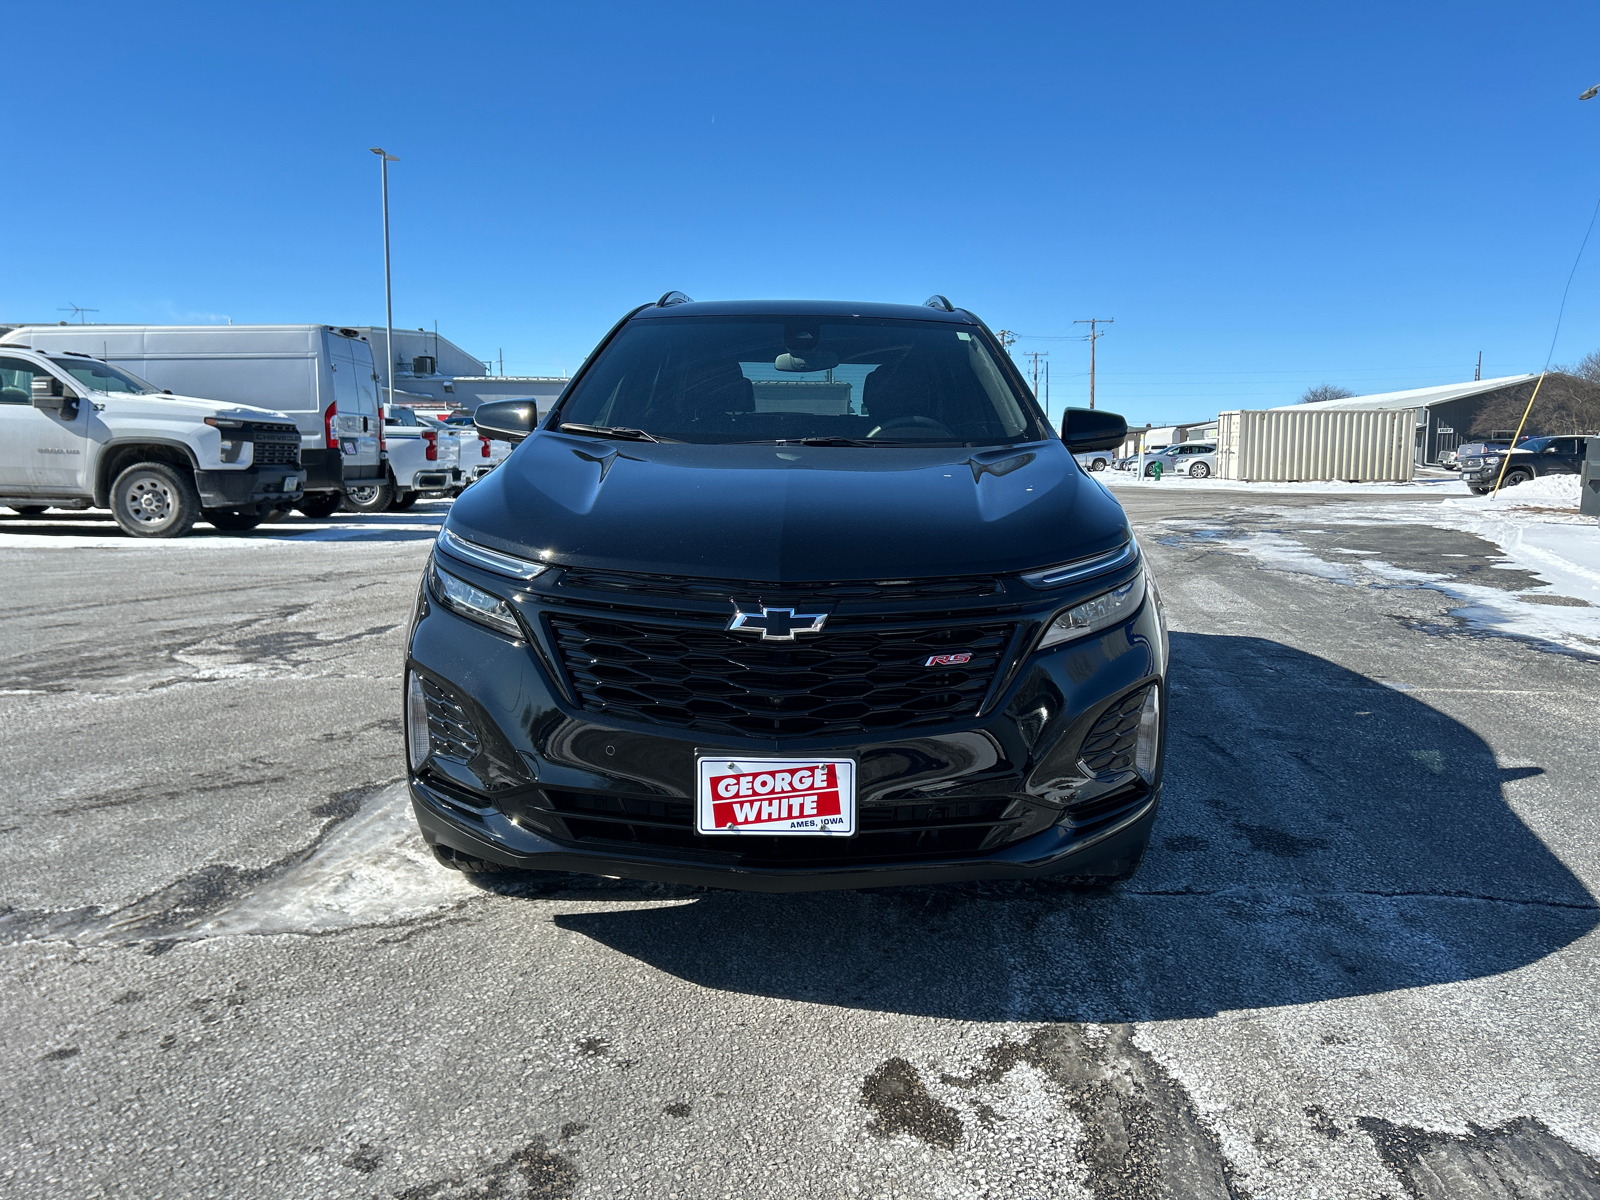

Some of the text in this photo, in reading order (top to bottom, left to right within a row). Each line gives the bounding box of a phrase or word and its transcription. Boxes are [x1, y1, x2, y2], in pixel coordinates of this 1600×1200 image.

[924, 652, 972, 667] RS
[717, 768, 828, 798] GEORGE
[732, 795, 818, 823] WHITE
[789, 817, 844, 829] AMES, IOWA
